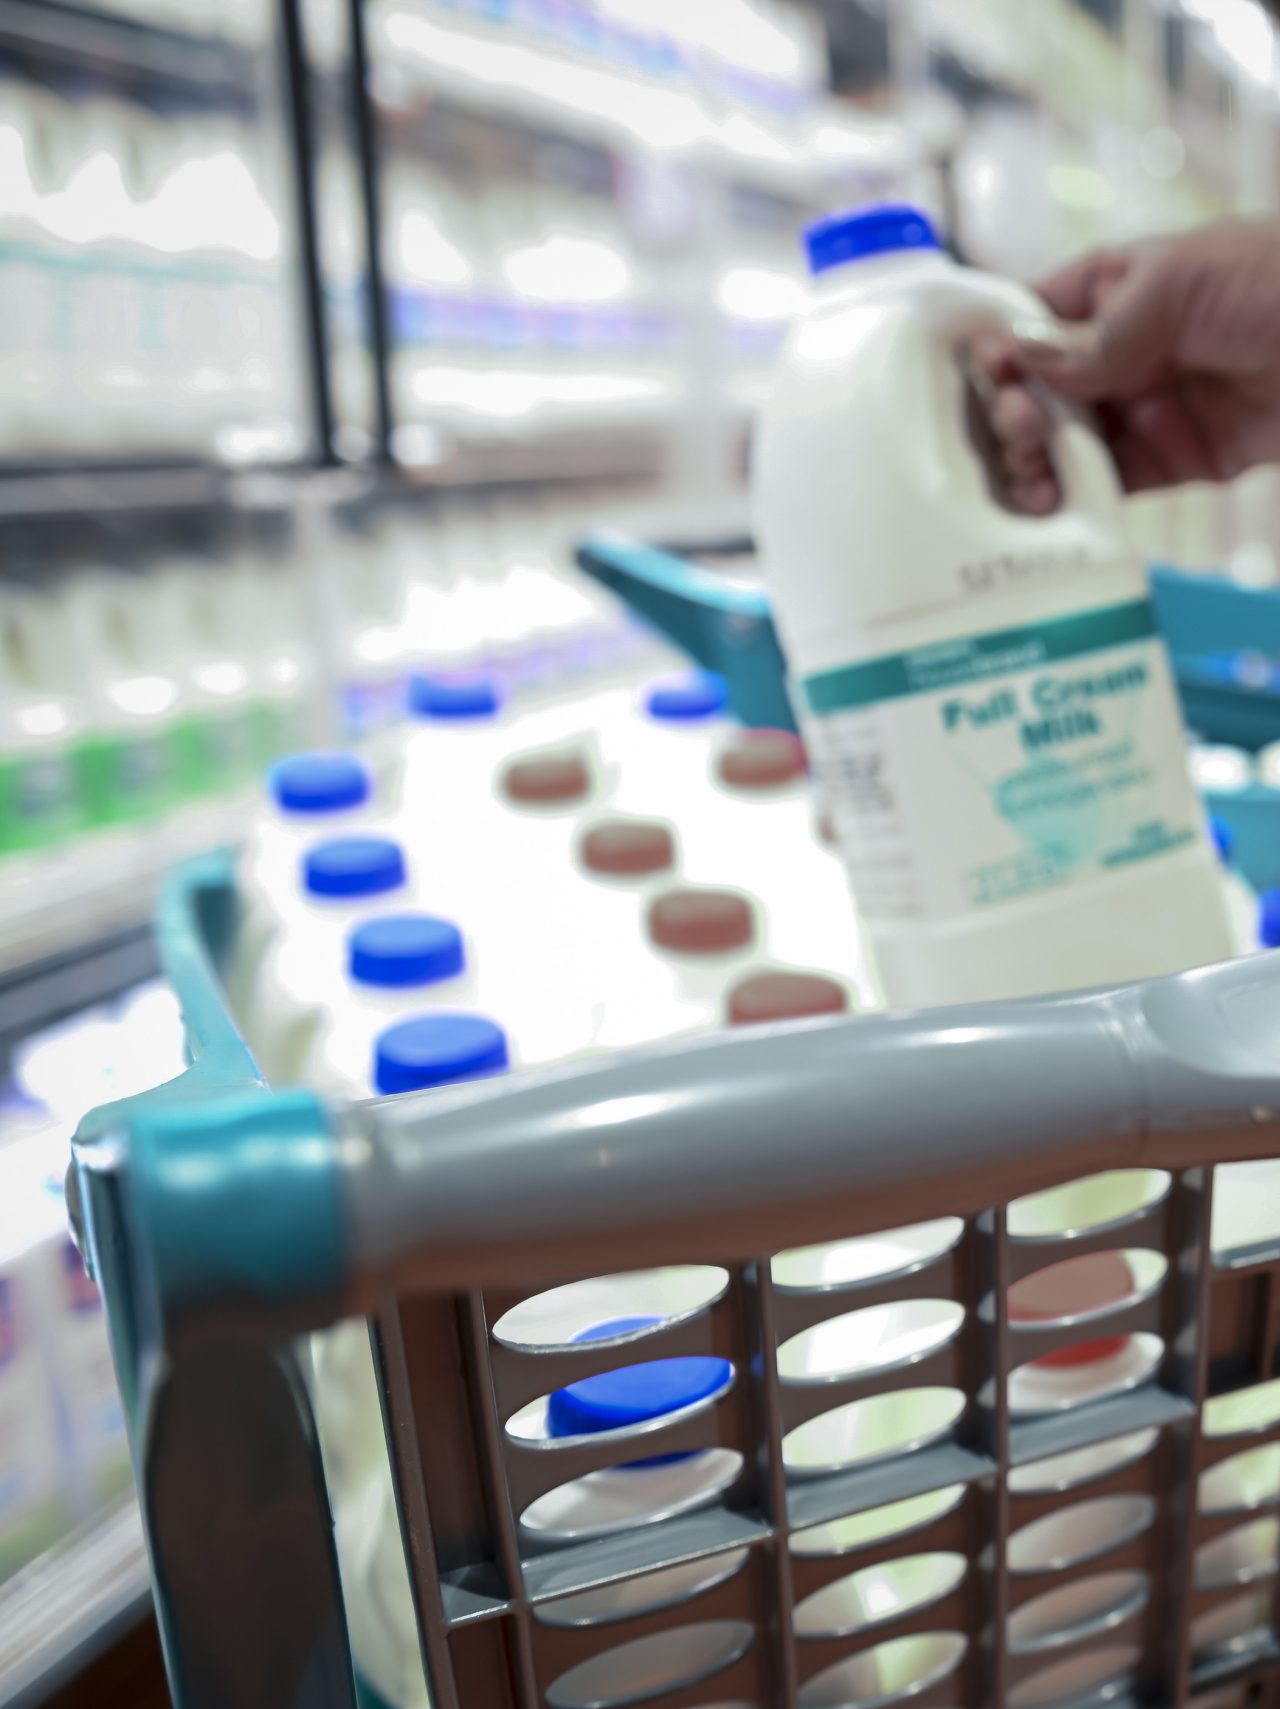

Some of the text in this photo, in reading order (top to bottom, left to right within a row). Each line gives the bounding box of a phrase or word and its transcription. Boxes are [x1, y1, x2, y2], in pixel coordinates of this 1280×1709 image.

[942, 689, 1016, 731] Full
[1031, 664, 1147, 708] Cream
[1020, 709, 1100, 749] Milk
